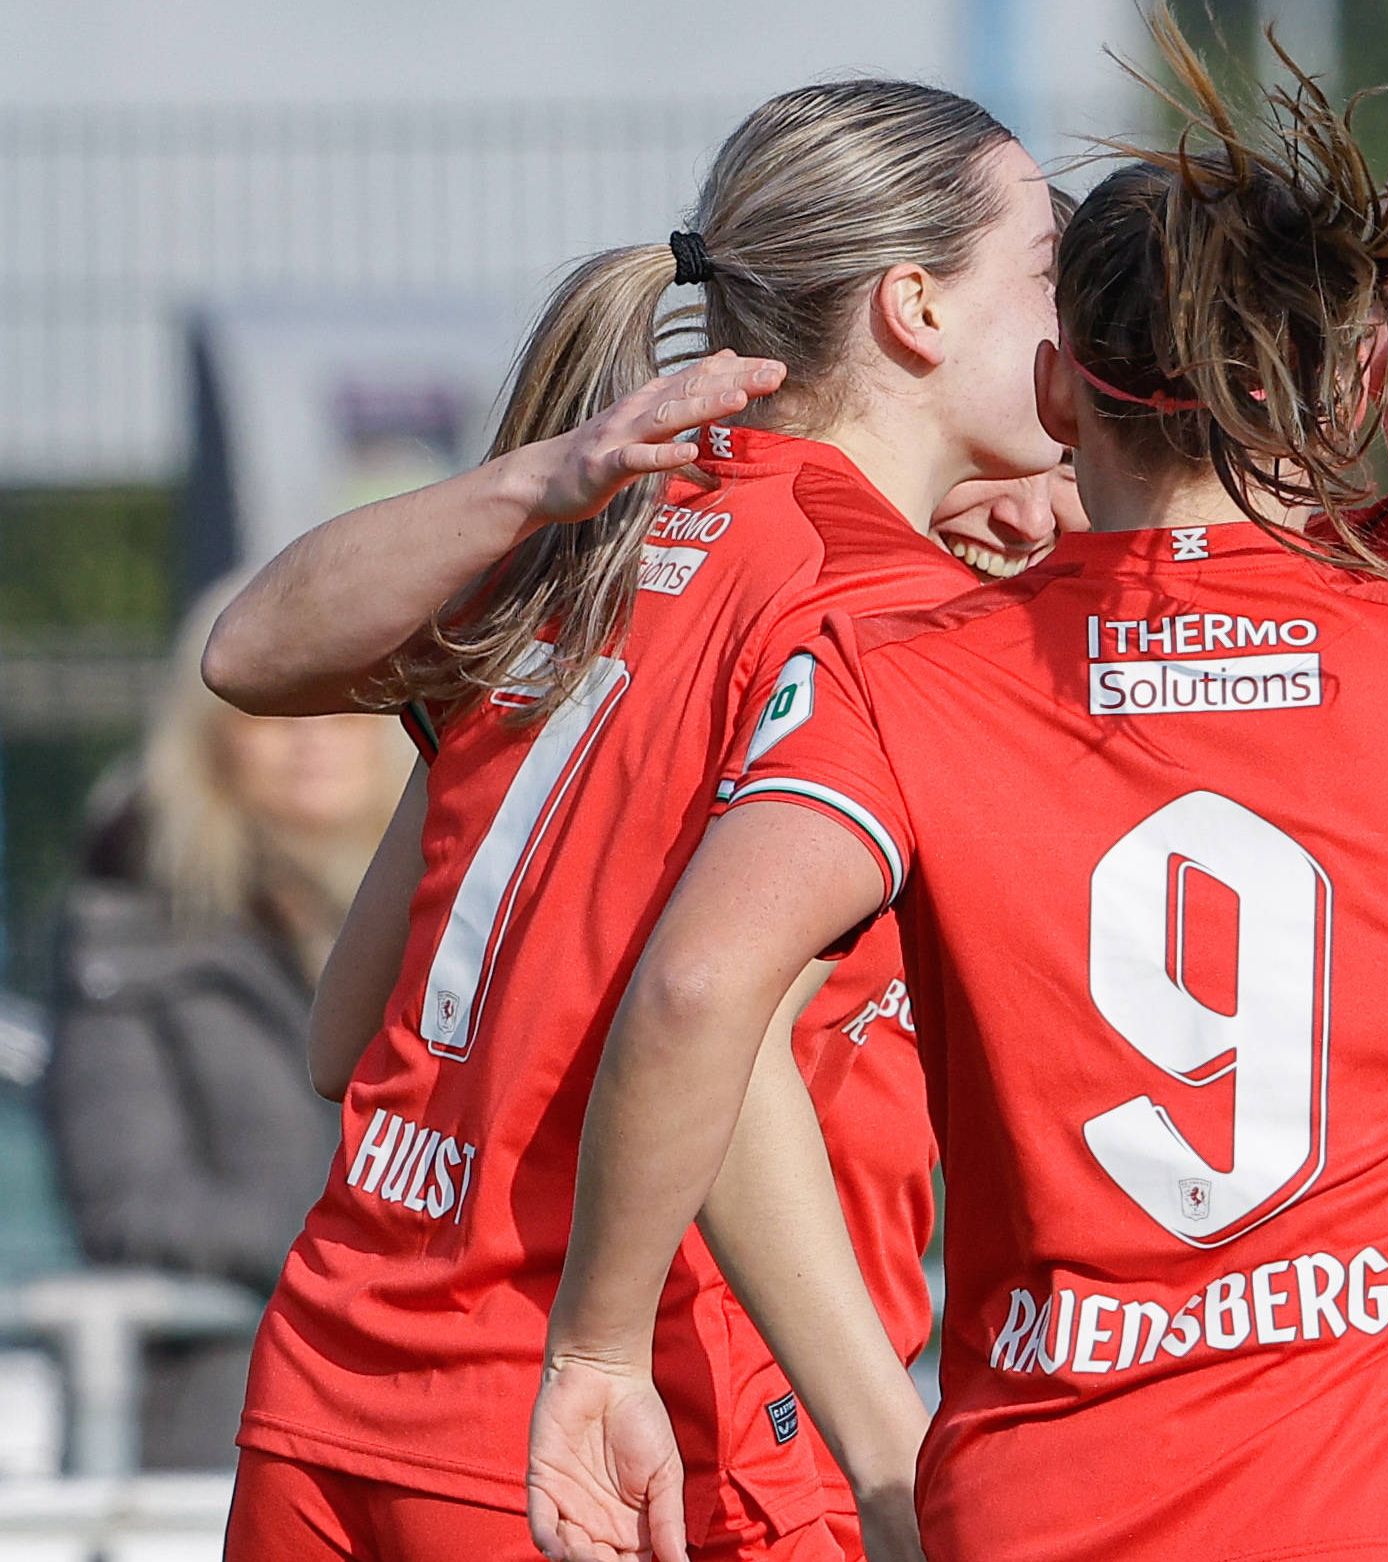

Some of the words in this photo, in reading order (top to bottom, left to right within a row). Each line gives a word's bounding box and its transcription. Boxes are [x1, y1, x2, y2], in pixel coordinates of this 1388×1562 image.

[1099, 665, 1311, 709] Solutions
[1082, 788, 1334, 1250] 9
[346, 1107, 476, 1225] HULST
